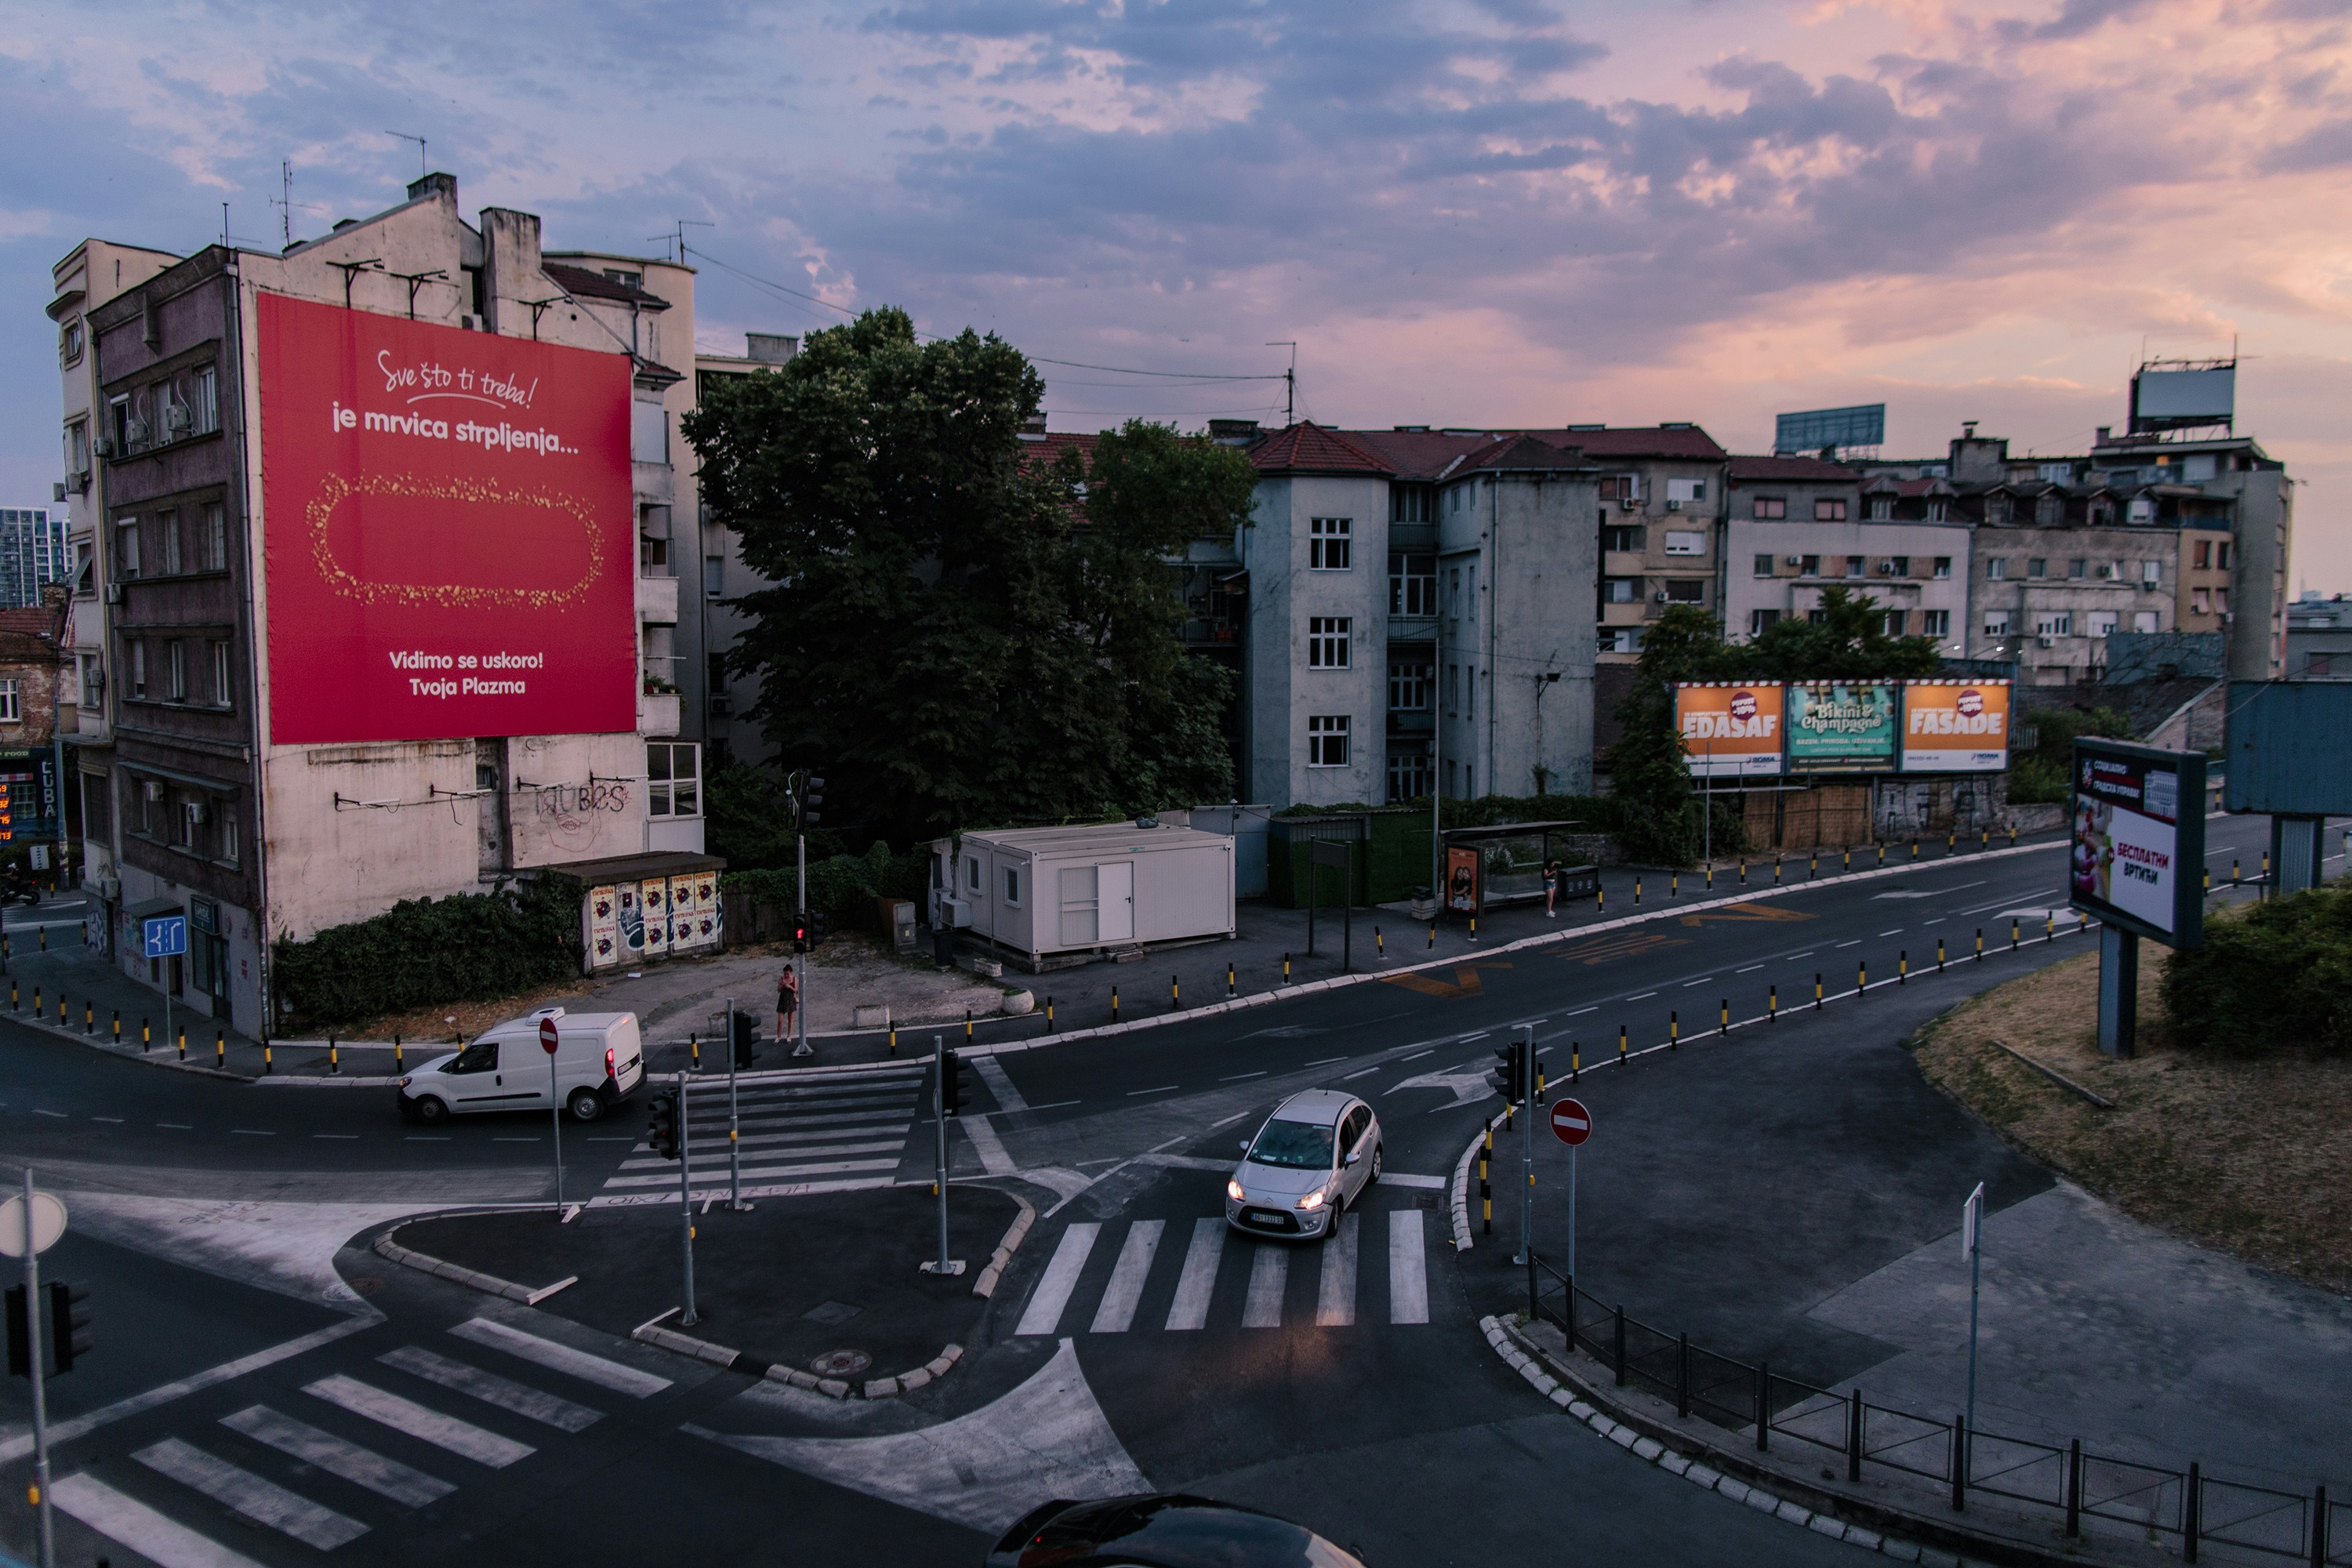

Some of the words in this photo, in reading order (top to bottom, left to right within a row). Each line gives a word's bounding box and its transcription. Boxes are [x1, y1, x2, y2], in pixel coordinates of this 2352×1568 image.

[378, 350, 417, 391] Sve
[421, 362, 451, 388] što
[458, 368, 474, 390] ti
[480, 373, 539, 408] treba!
[333, 401, 356, 433] je
[365, 412, 448, 439] mrvica
[456, 420, 578, 456] strpljenja...
[390, 651, 452, 669] Vidimo
[458, 655, 477, 668] se
[483, 652, 543, 668] uskoro!
[409, 677, 457, 699] Tvoja
[463, 677, 525, 694] Plazma
[1733, 706, 1756, 715] -10%
[1815, 702, 1861, 719] Bikini
[1958, 703, 1982, 713] -10%
[1682, 714, 1778, 739] EDASAF
[1801, 714, 1882, 734] Champagne
[1910, 713, 2003, 735] FASADE
[2117, 842, 2169, 869] БЕСПЛАТНИ
[2124, 862, 2158, 885] ВРТИЋИ
